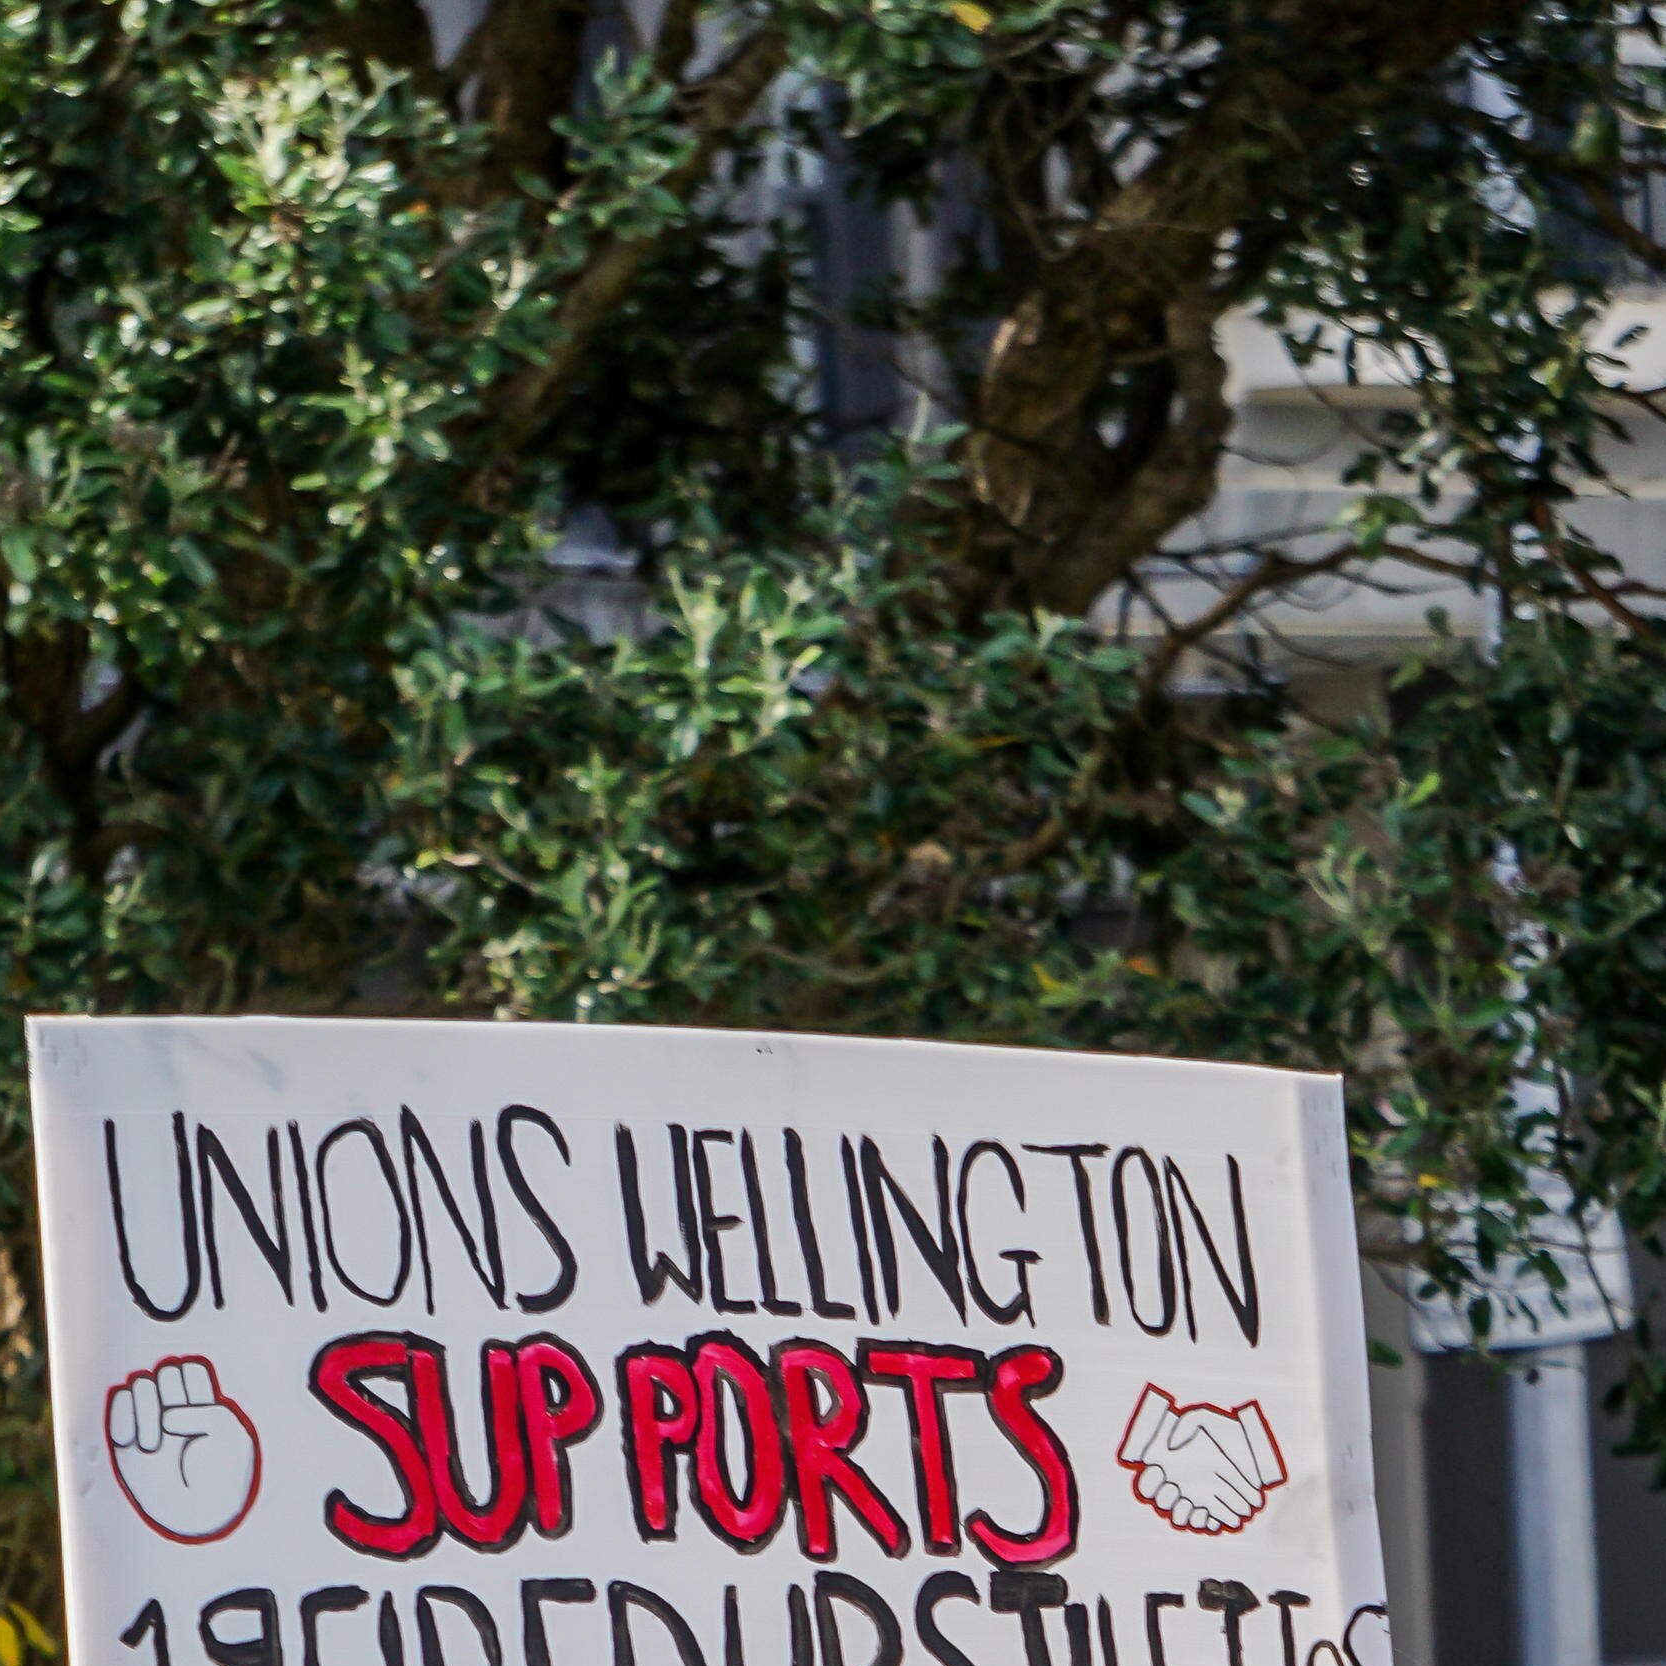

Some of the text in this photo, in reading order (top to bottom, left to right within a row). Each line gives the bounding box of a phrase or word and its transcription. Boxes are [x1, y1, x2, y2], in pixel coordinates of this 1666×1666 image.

[104, 1104, 577, 1322] UNIONS
[614, 1120, 1261, 1347] WELLINGTON
[308, 1329, 1079, 1567] SUPPORTS
